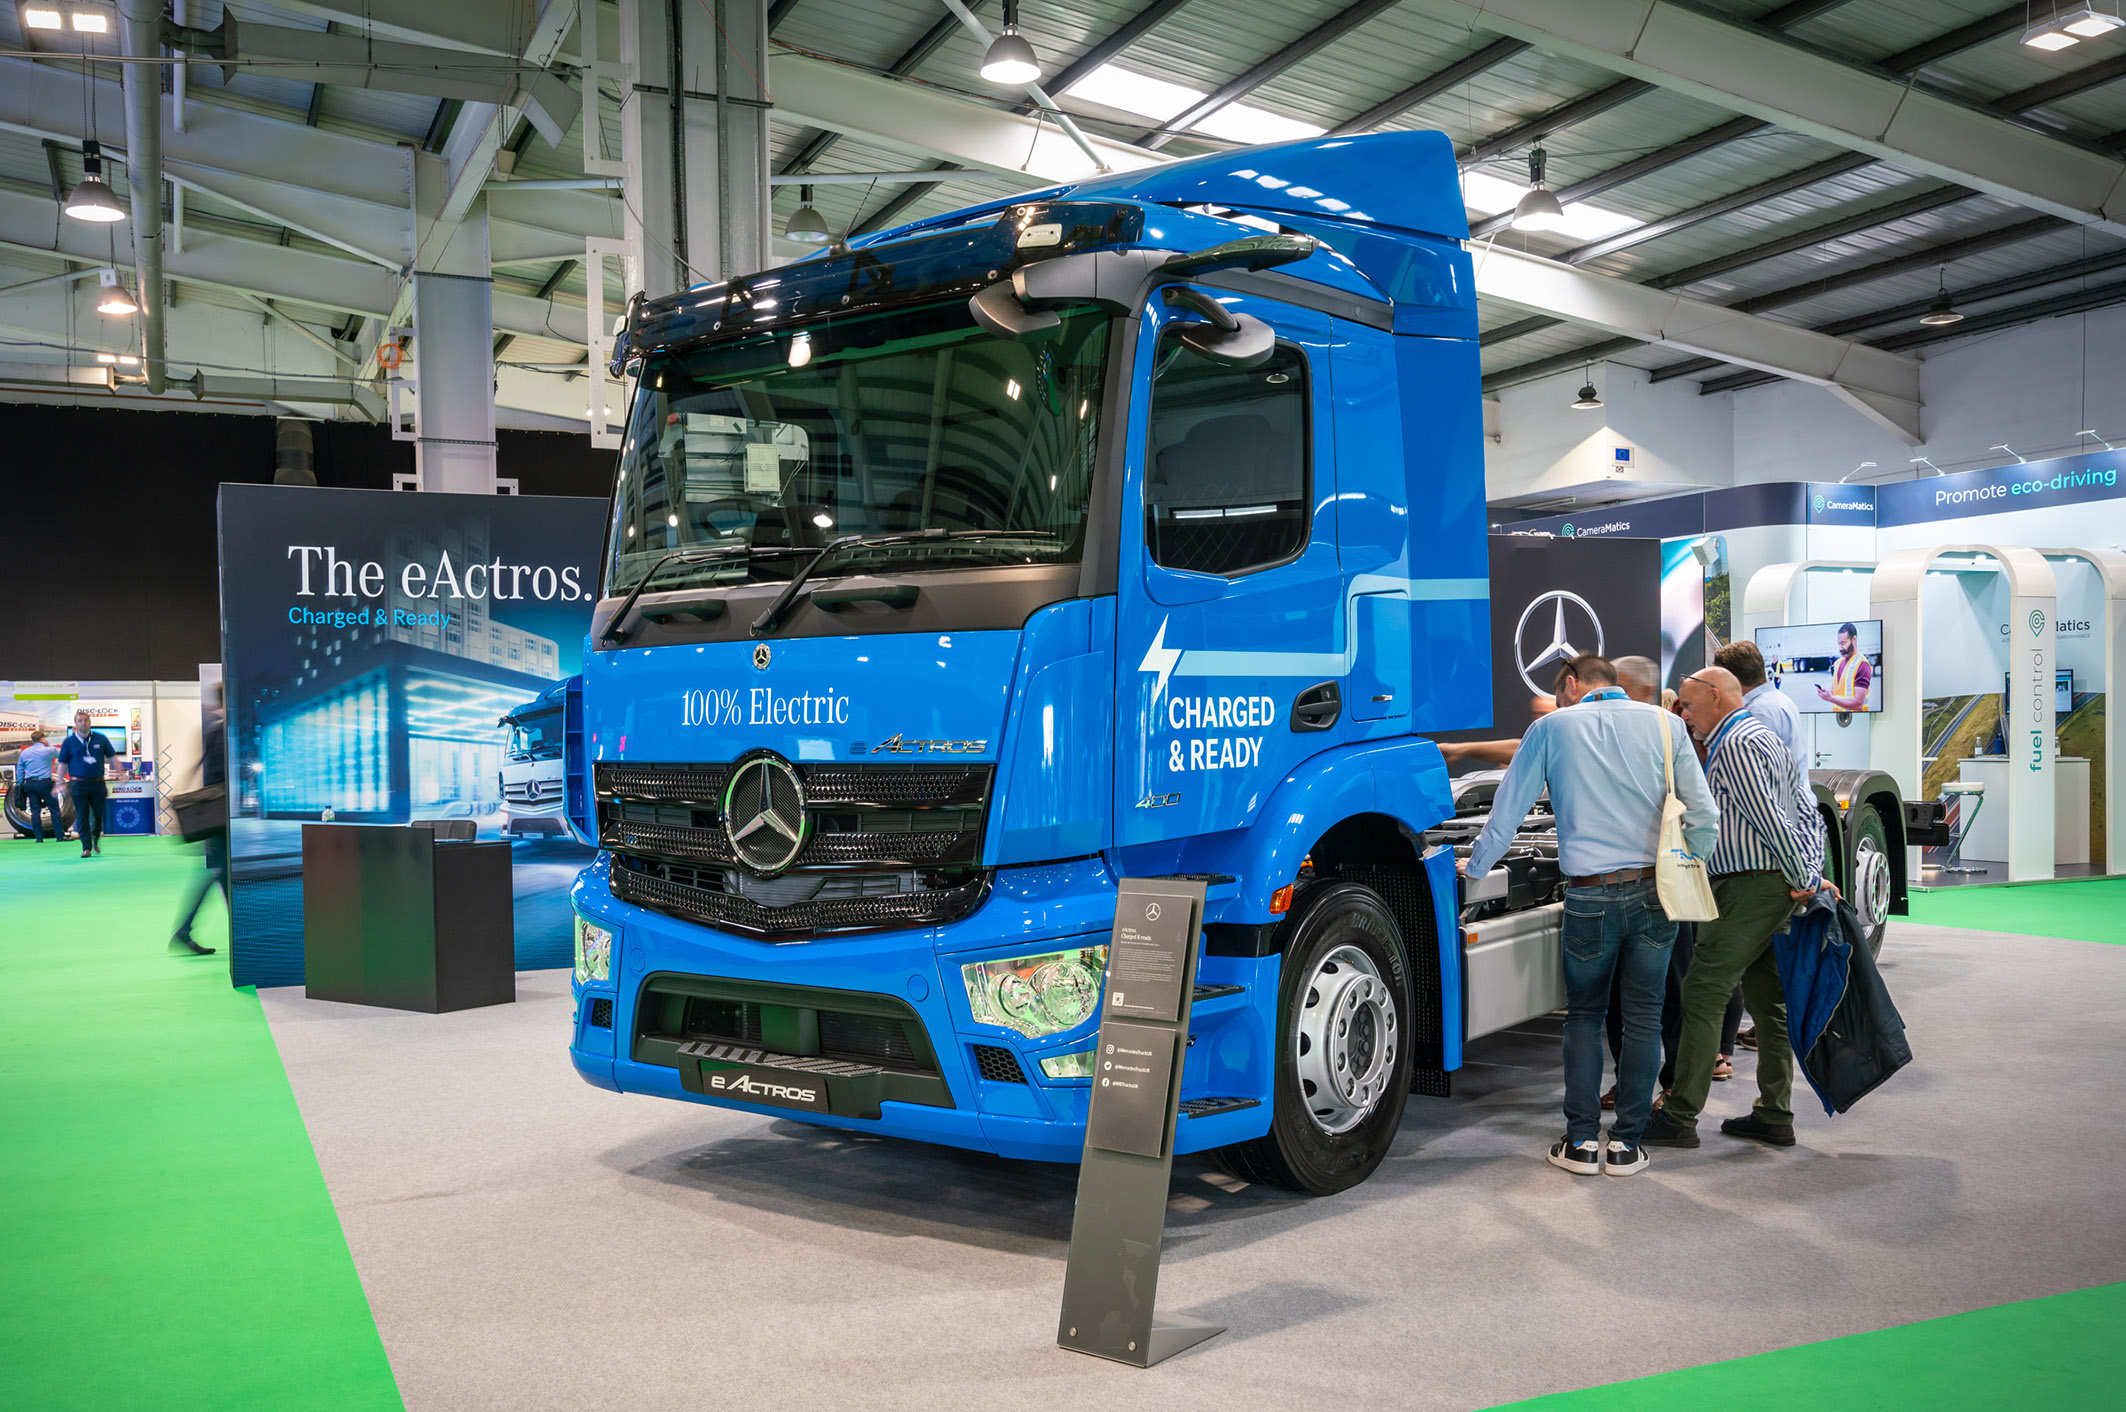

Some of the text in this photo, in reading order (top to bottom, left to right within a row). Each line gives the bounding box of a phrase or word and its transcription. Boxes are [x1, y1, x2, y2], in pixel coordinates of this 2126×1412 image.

[1936, 468, 2117, 506] Promote eco-driving
[1826, 500, 1874, 512] CameraMatics
[1576, 521, 1631, 537] CameraMatics
[287, 545, 593, 601] The eActros.
[288, 606, 451, 630] Charged & Ready
[681, 686, 849, 726] 100% Electric
[1168, 695, 1276, 730] CHARGED
[2029, 648, 2044, 773] fuel control
[1168, 736, 1264, 772] & READY
[1134, 792, 1181, 809] 400
